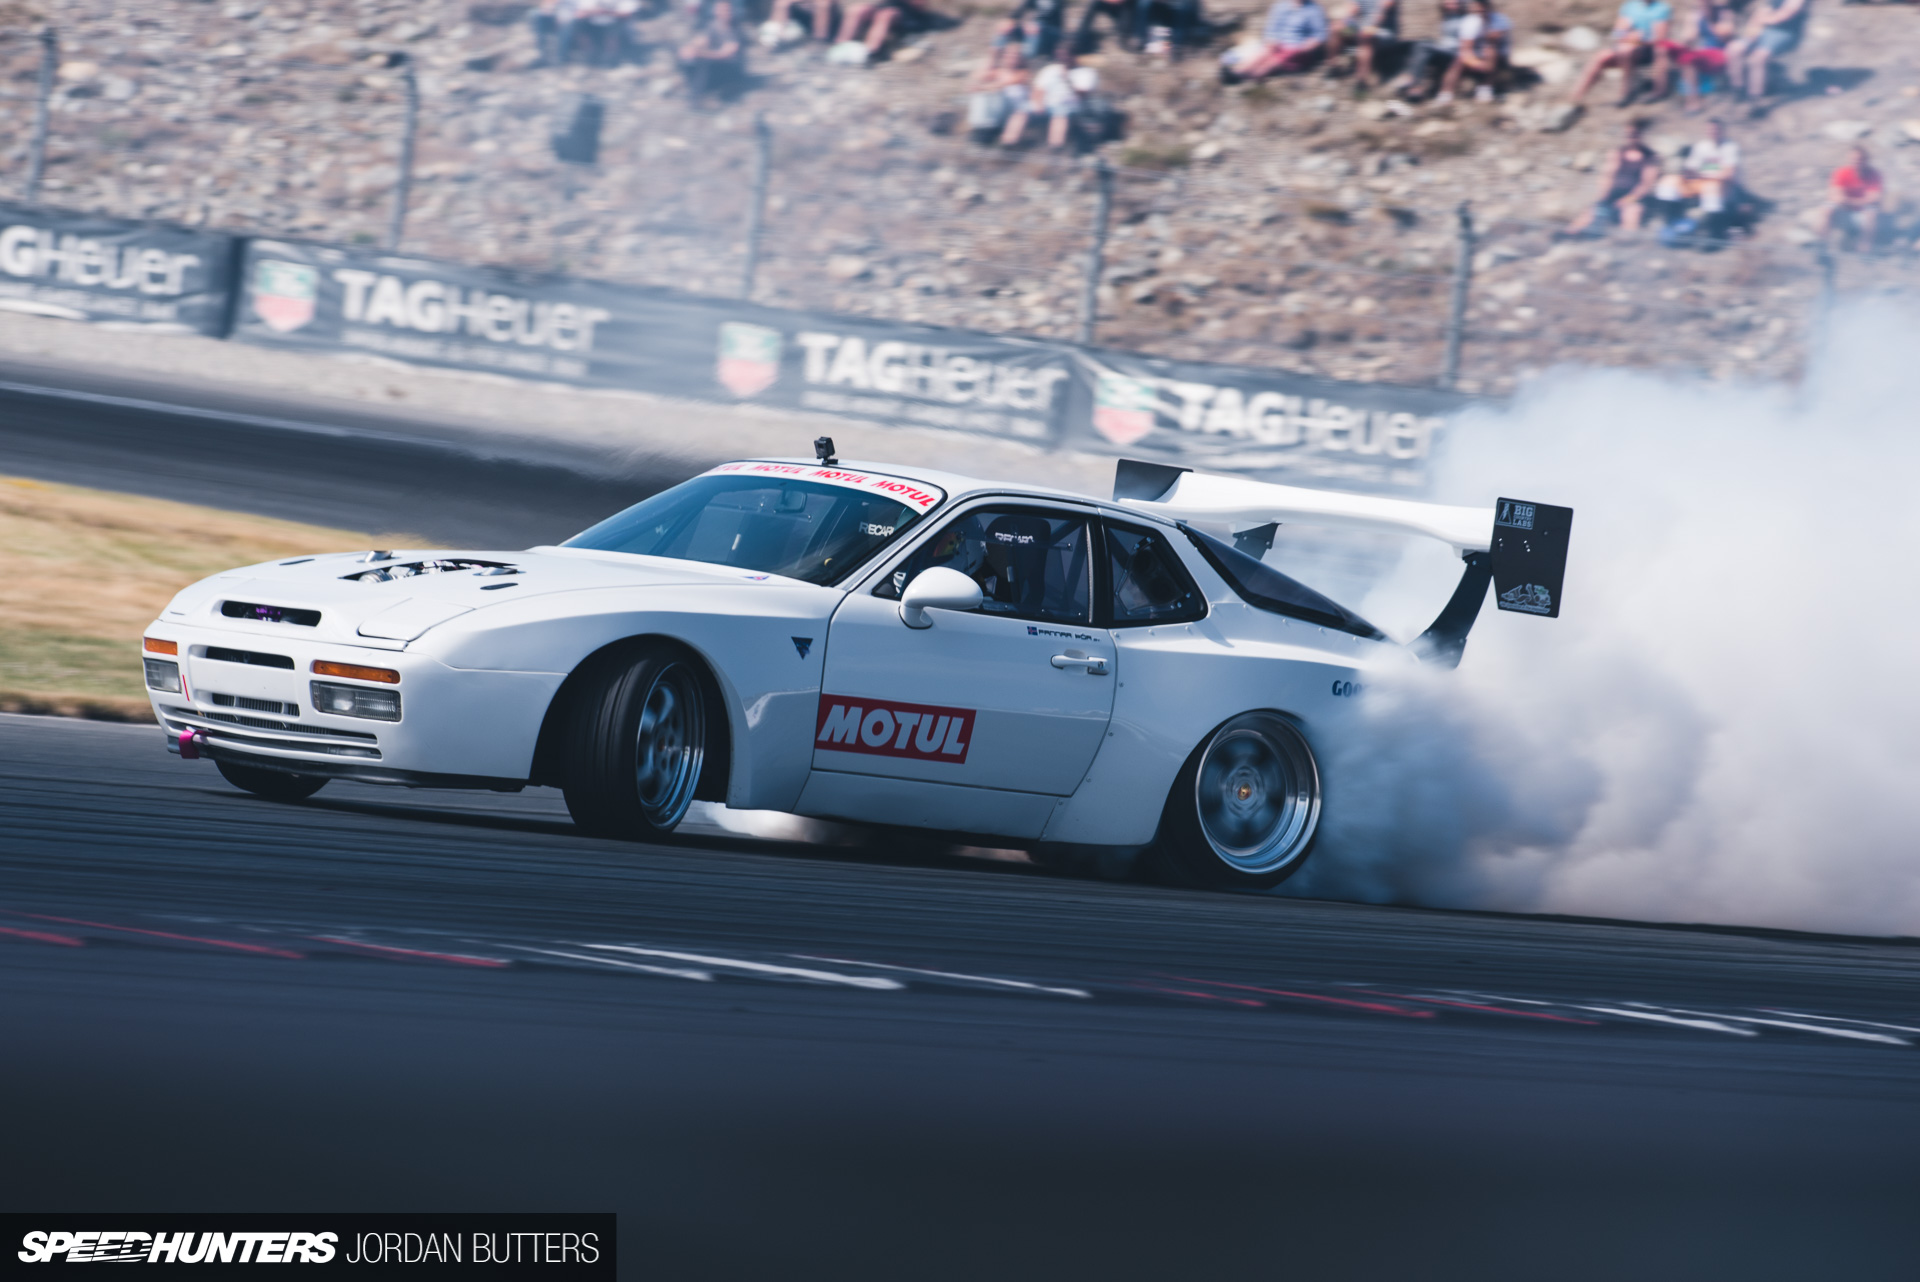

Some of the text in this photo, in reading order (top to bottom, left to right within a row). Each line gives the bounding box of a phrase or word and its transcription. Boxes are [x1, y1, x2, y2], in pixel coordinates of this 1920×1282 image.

[809, 470, 868, 484] MOTUL
[870, 480, 936, 507] MOTUL
[1514, 505, 1533, 517] BIG
[858, 521, 895, 537] RECAR
[1512, 518, 1533, 528] LABS
[1332, 680, 1364, 697] GOO
[817, 704, 965, 755] MOTUL
